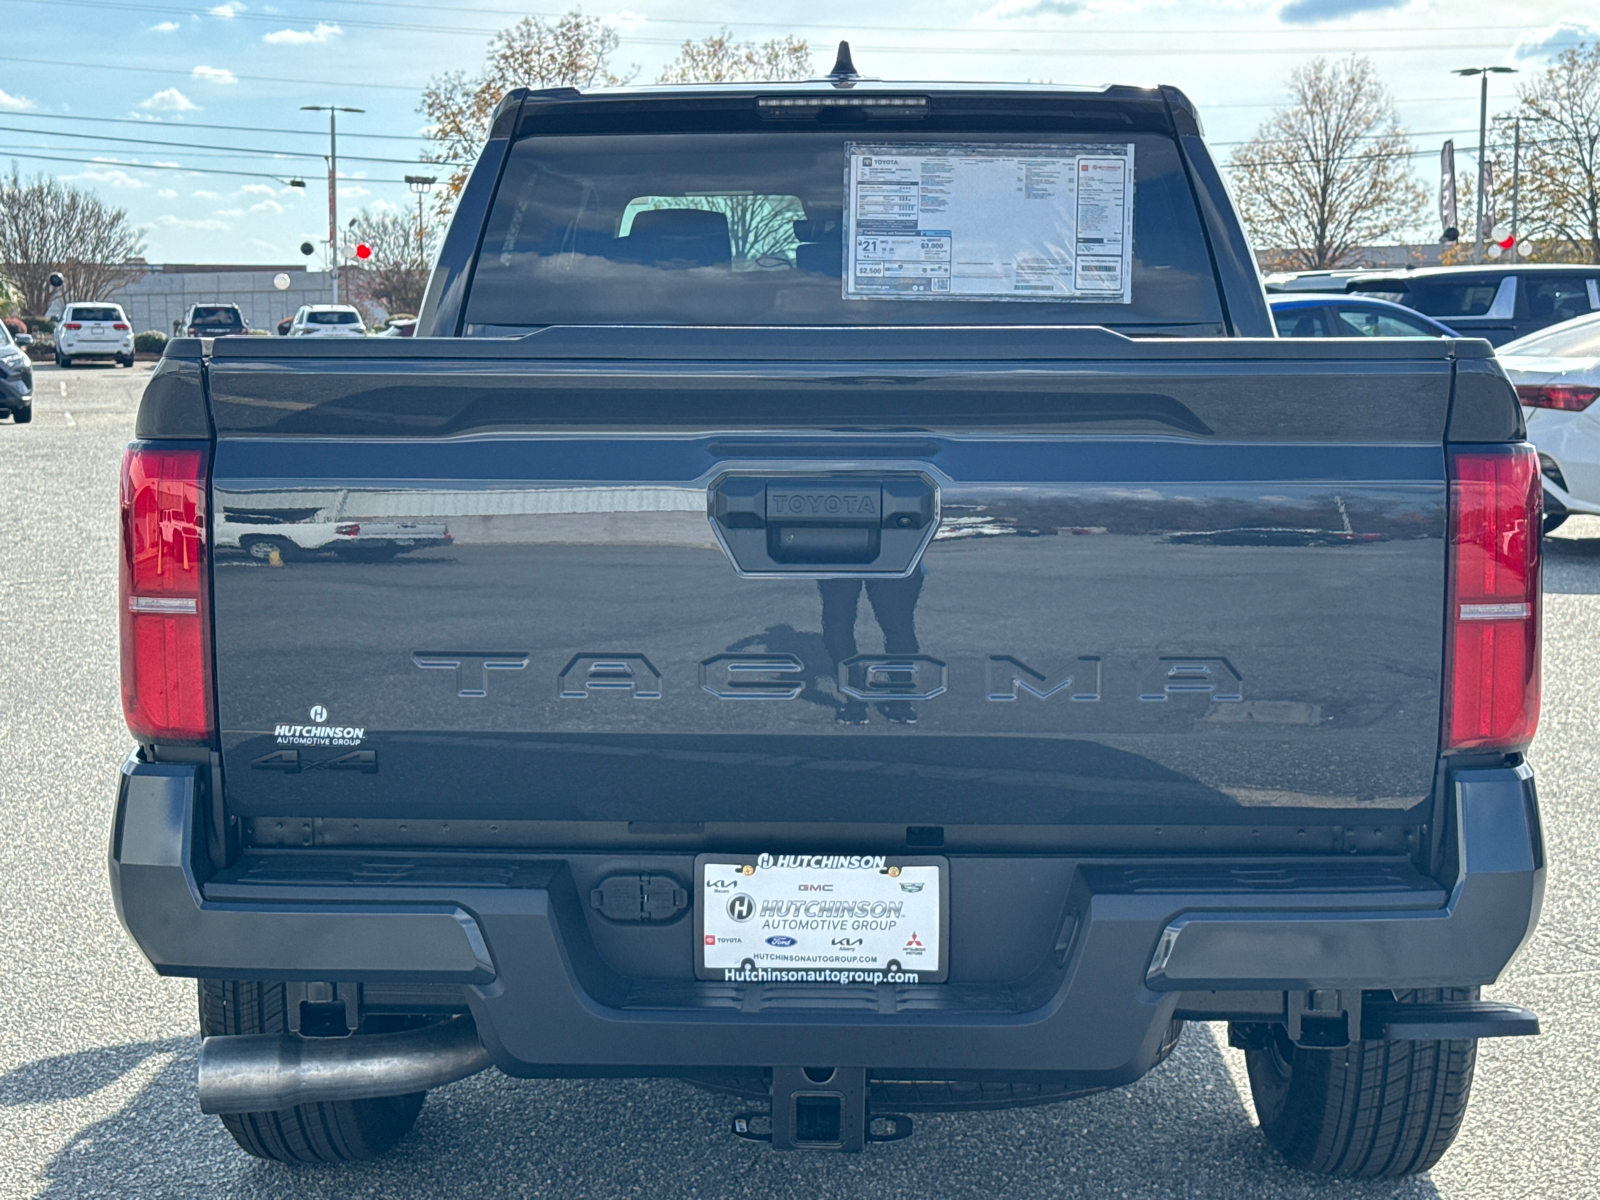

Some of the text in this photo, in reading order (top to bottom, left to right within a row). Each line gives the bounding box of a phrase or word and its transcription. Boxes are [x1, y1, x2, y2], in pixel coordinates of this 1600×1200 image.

[862, 240, 877, 252] 21
[772, 494, 876, 513] TOYOTA
[411, 650, 1244, 702] TACOMA
[274, 725, 364, 739] HUTCHINSON
[276, 737, 330, 745] AUTOMOTIVE
[776, 855, 886, 869] HUTCHINSON
[759, 900, 903, 918] HUTCHINSON
[762, 919, 897, 931] AUTOMOTIVE GROUP
[753, 953, 878, 963] HUTCHINSONAUTOGROUP.COM
[724, 968, 919, 984] Hutchinsonautogroup.com
